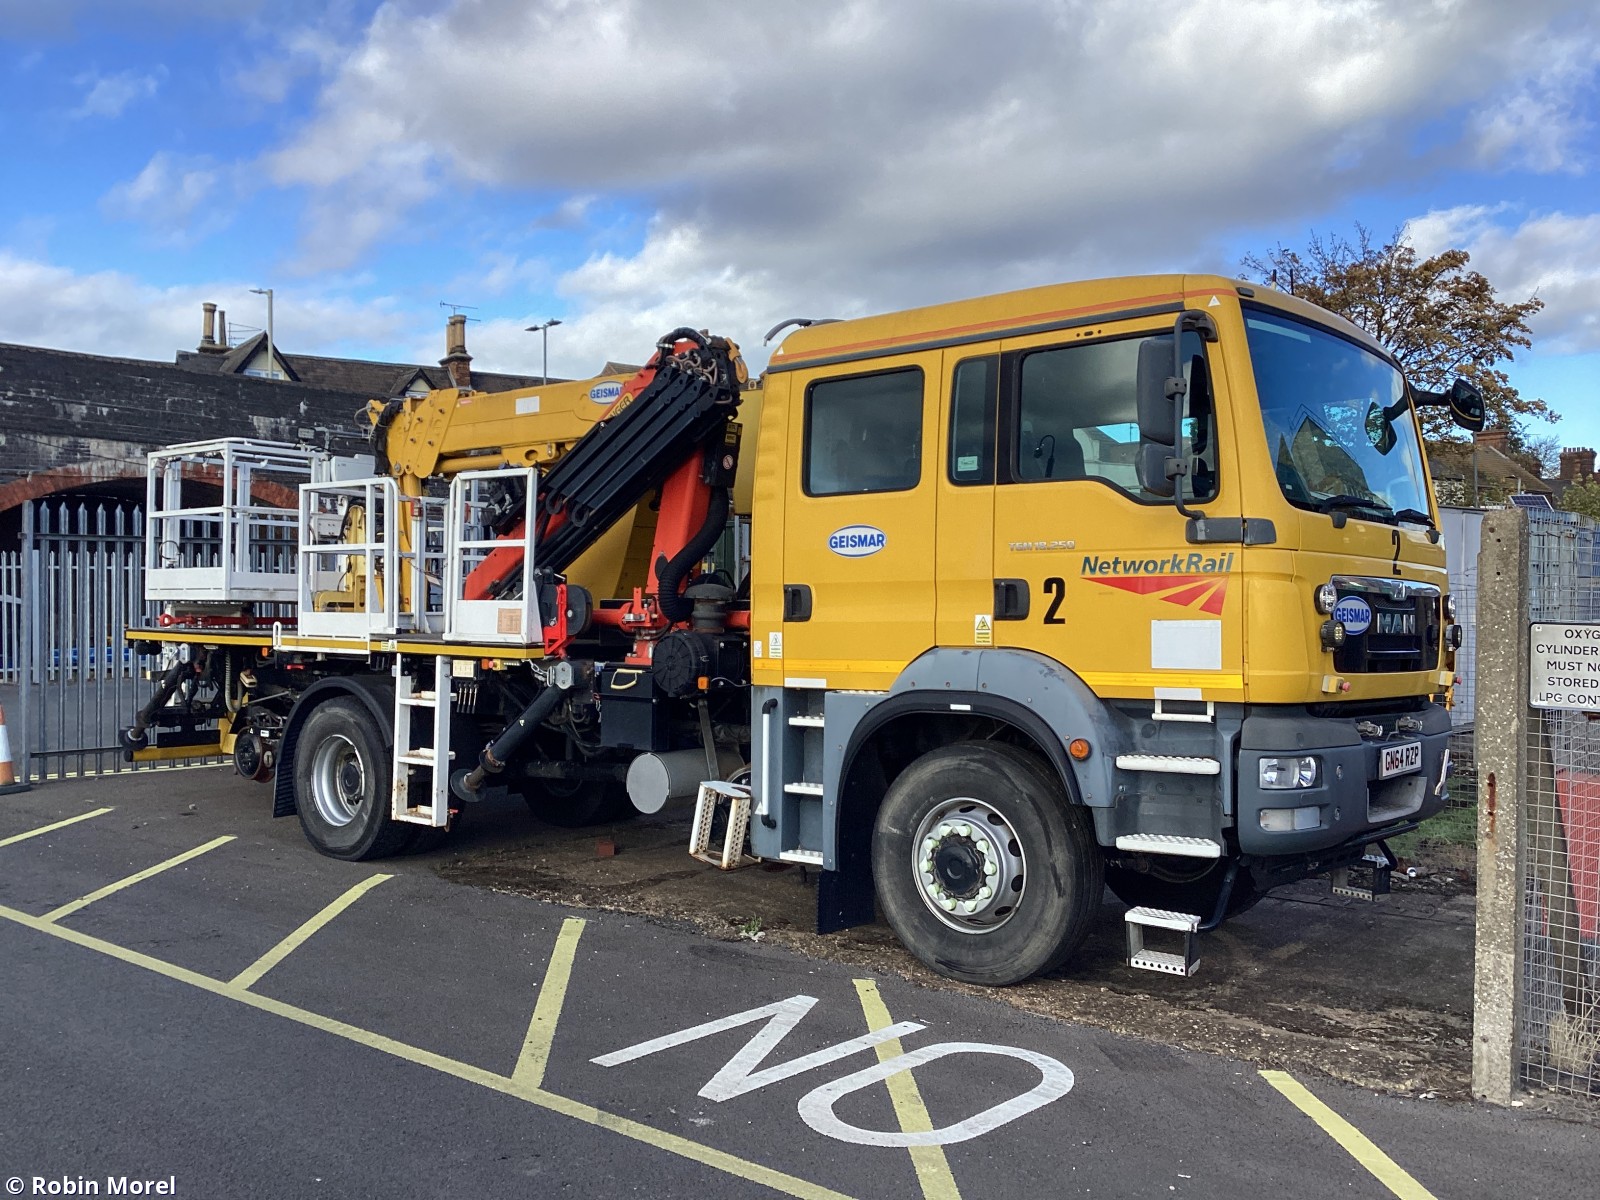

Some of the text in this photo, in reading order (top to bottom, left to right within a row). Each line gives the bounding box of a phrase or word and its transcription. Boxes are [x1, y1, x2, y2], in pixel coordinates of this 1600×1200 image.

[590, 386, 623, 399] GEISMA
[829, 533, 885, 549] GEISMAR
[1008, 541, 1032, 551] TGM
[1392, 530, 1401, 575] 2
[1081, 552, 1235, 576] NetworkRail
[1043, 577, 1066, 625] 2
[1335, 607, 1370, 624] GEISMAR
[1377, 612, 1416, 634] MAN
[1546, 660, 1583, 671] MUST
[1547, 676, 1599, 689] STORED
[1539, 692, 1562, 702] LPG
[1385, 746, 1419, 771] GN64 RZP
[589, 994, 1075, 1148] NO
